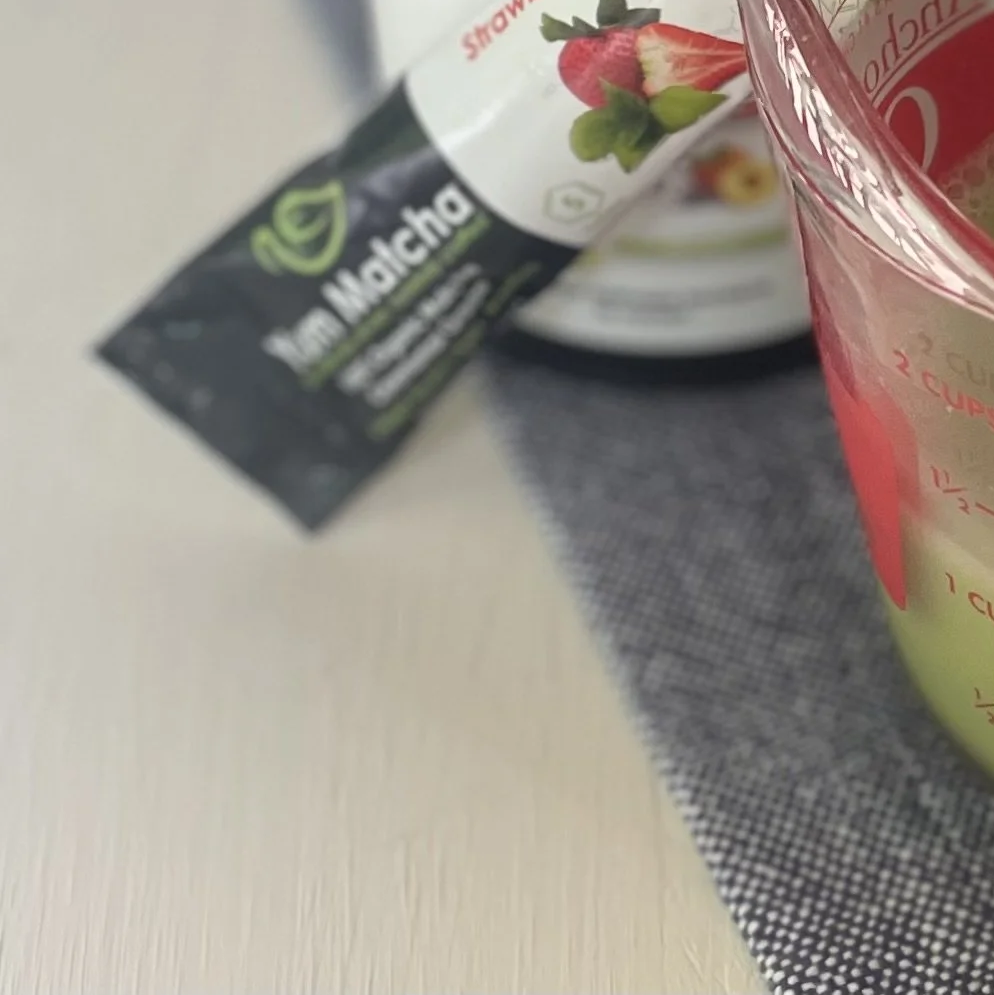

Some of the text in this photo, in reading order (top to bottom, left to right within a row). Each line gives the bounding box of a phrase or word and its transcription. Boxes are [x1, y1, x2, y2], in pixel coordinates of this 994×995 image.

[321, 183, 472, 325] Matcha
[894, 349, 911, 377] 2
[945, 572, 955, 593] 1
